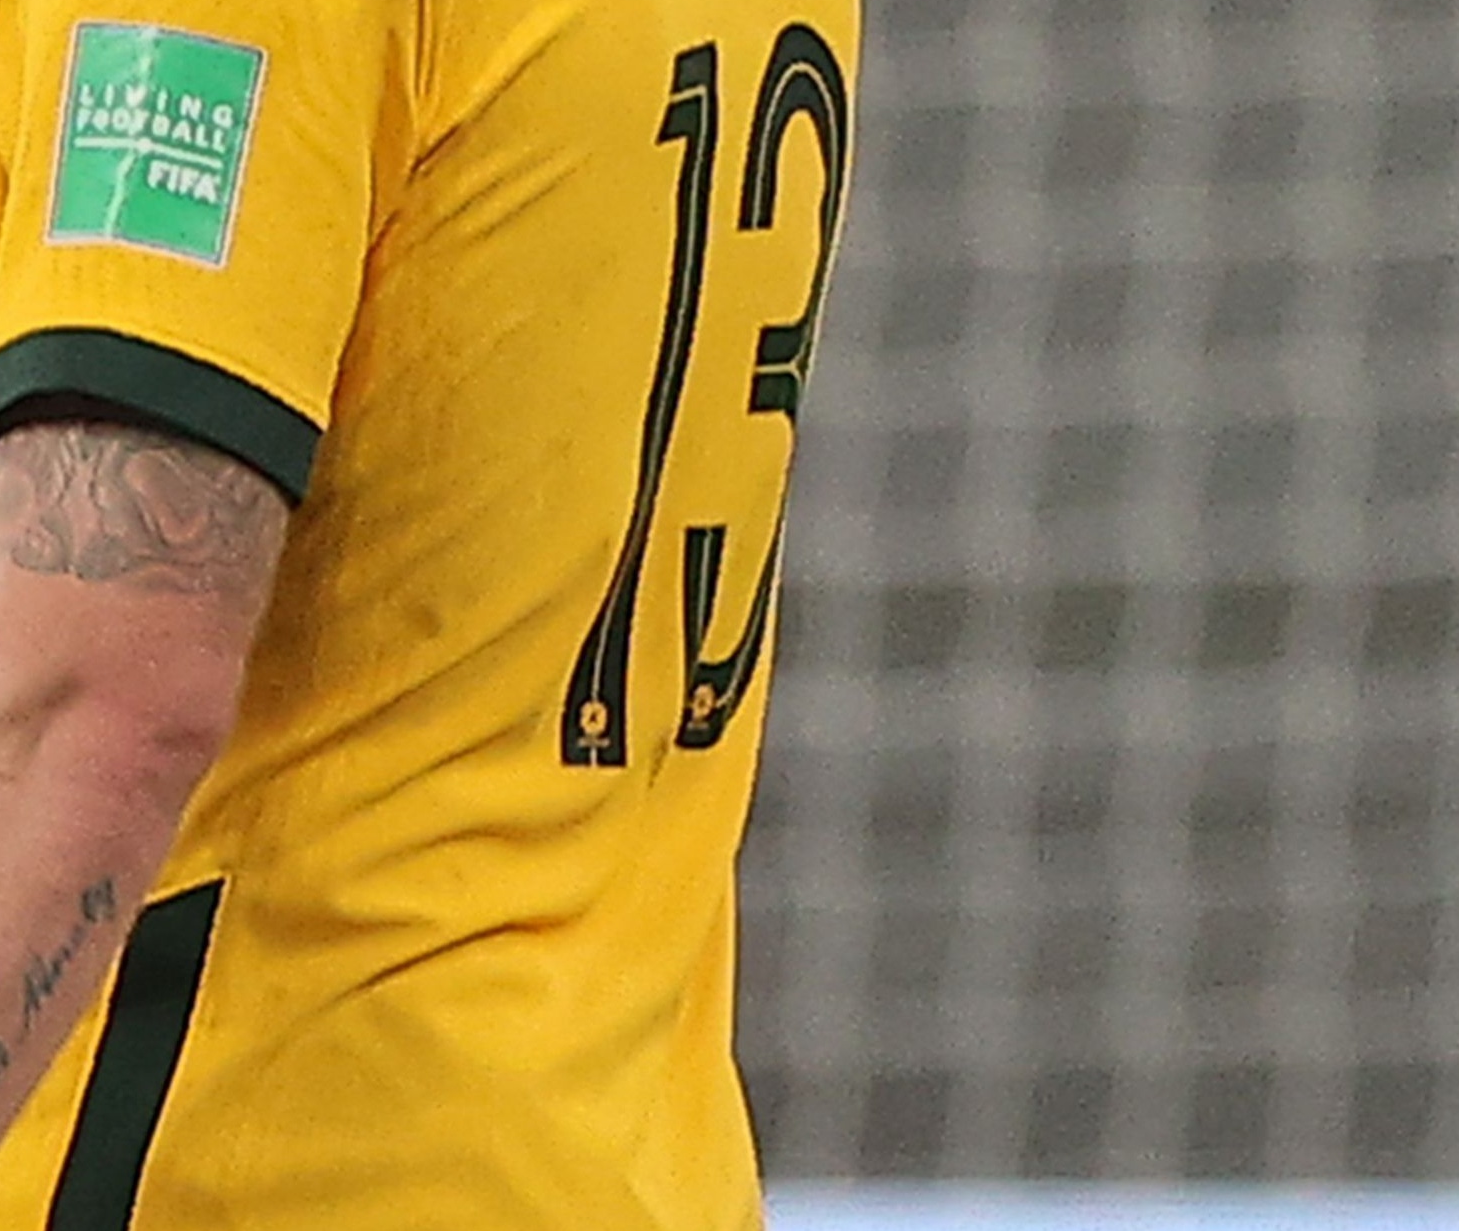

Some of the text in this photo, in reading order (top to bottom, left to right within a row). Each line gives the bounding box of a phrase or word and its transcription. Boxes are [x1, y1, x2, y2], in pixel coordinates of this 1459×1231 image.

[79, 84, 233, 129] LIVING
[147, 159, 219, 204] FIFA
[561, 22, 850, 767] 13
